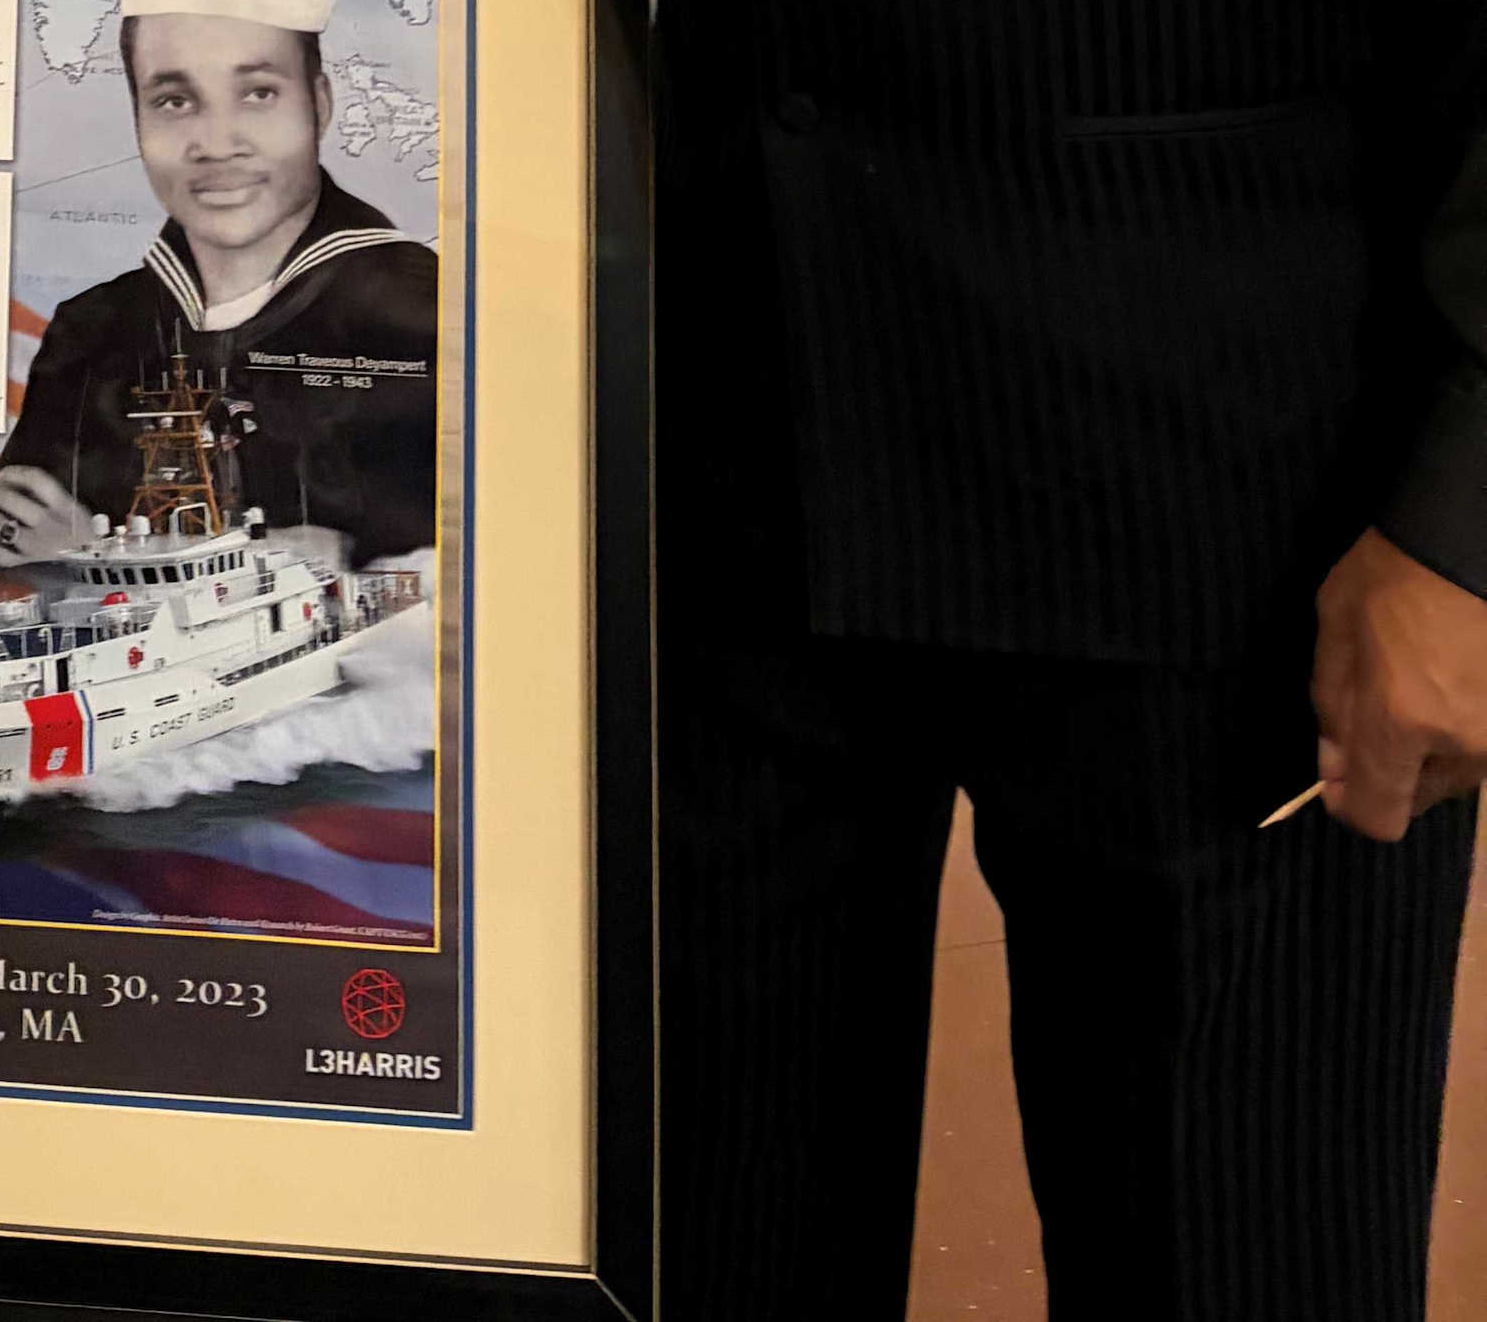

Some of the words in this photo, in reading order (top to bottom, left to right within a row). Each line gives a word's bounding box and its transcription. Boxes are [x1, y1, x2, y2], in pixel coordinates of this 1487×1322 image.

[248, 352, 295, 364] Warren
[355, 356, 427, 373] Deyampert
[302, 374, 332, 387] 1922
[342, 376, 372, 388] 1943
[150, 712, 192, 738] COAST
[197, 697, 234, 722] GUARD
[102, 974, 159, 1008] 30,
[175, 979, 267, 1018] 2023
[21, 1007, 85, 1043] MA
[305, 1048, 442, 1081] L3HARRIS
